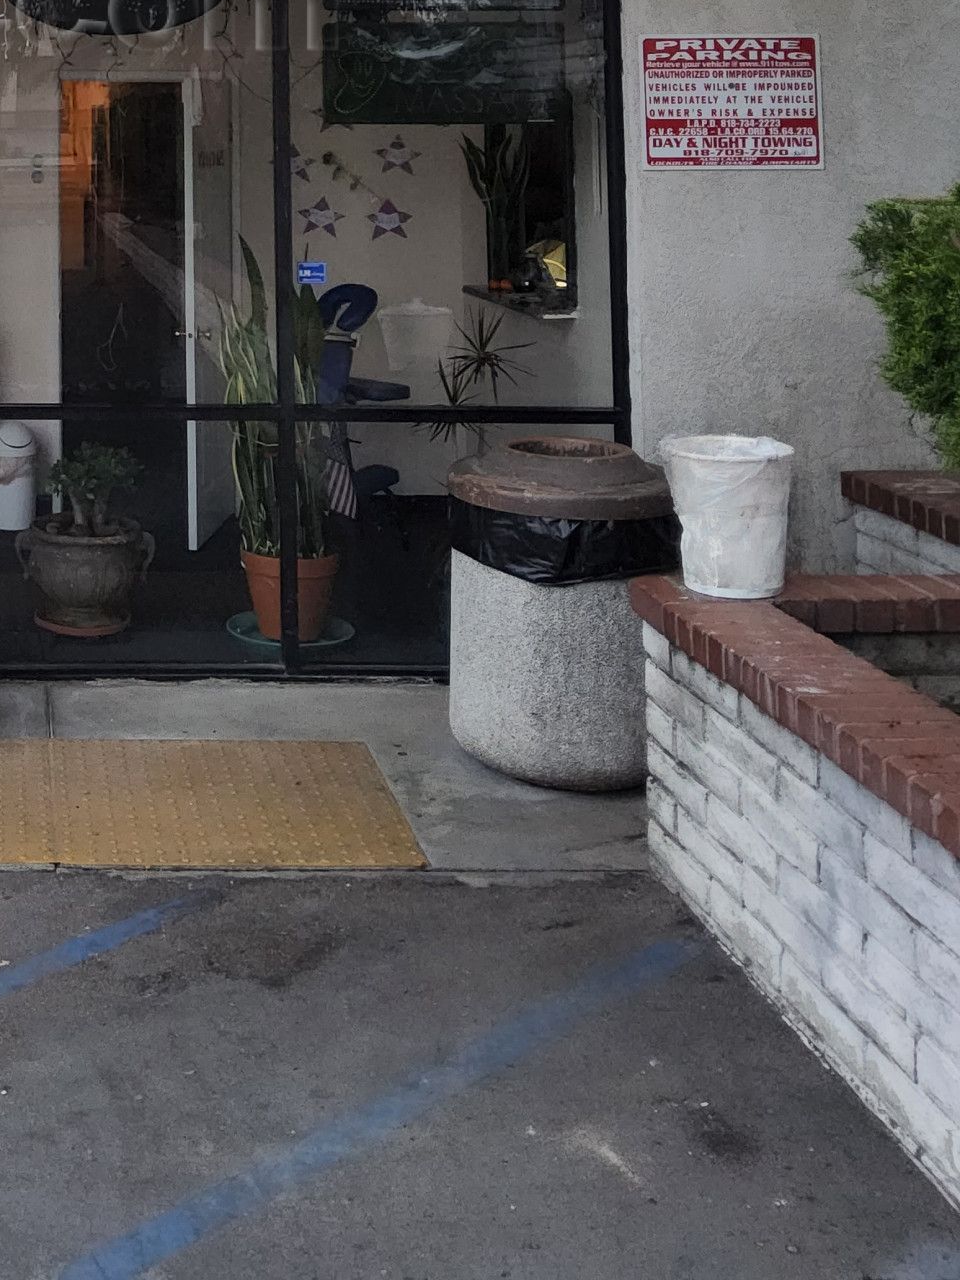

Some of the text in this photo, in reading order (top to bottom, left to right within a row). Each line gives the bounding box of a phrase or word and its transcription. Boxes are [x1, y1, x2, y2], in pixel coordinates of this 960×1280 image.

[655, 39, 800, 50] PRIVATE
[647, 50, 812, 61] PARKING
[648, 70, 812, 79] UNAUTHORIZED OR IMPROPERLY PARKED
[648, 82, 814, 91] VEHICLES WILL BE IMPOUNDED
[648, 95, 814, 104] IMMEDIATELY AT THE VEHICLE
[649, 108, 815, 117] OWNER'S RISK & EXPENSE
[652, 137, 813, 148] DAY & NIGHT TOWING
[683, 148, 789, 157] 818-709-7970
